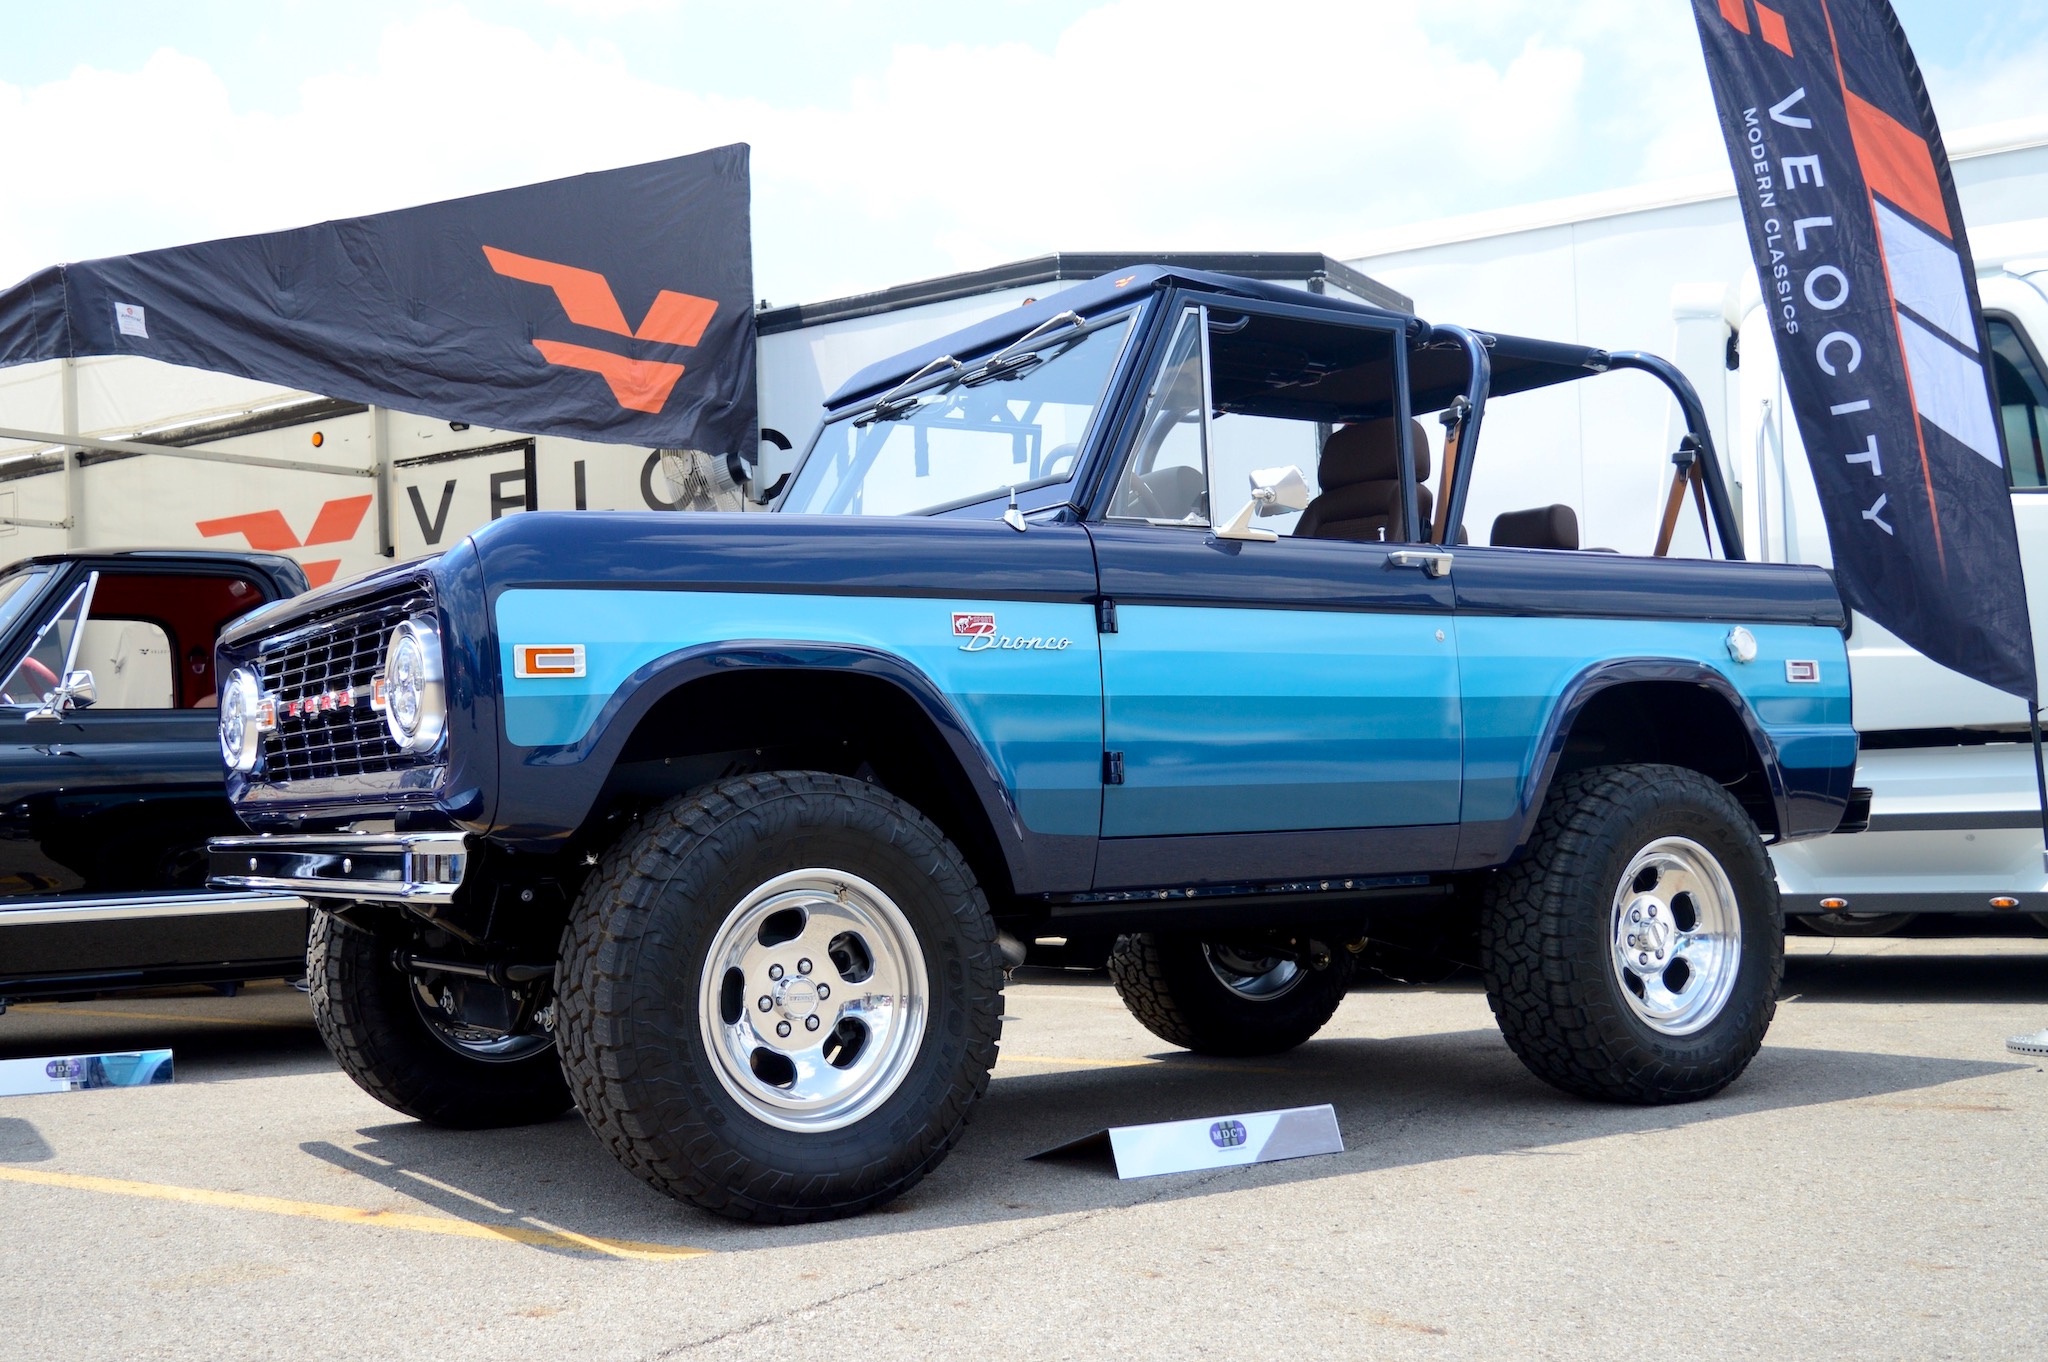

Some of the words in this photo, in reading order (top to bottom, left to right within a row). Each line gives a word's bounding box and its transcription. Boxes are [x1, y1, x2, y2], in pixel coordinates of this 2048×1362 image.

[1742, 107, 1775, 207] MODERN
[1764, 219, 1798, 335] CLASSICS
[1769, 86, 1894, 536] VELOCITY
[959, 622, 1073, 651] Bronco
[288, 689, 354, 717] FORD
[49, 1064, 79, 1073] MDCT
[1212, 1128, 1244, 1140] MDCT
